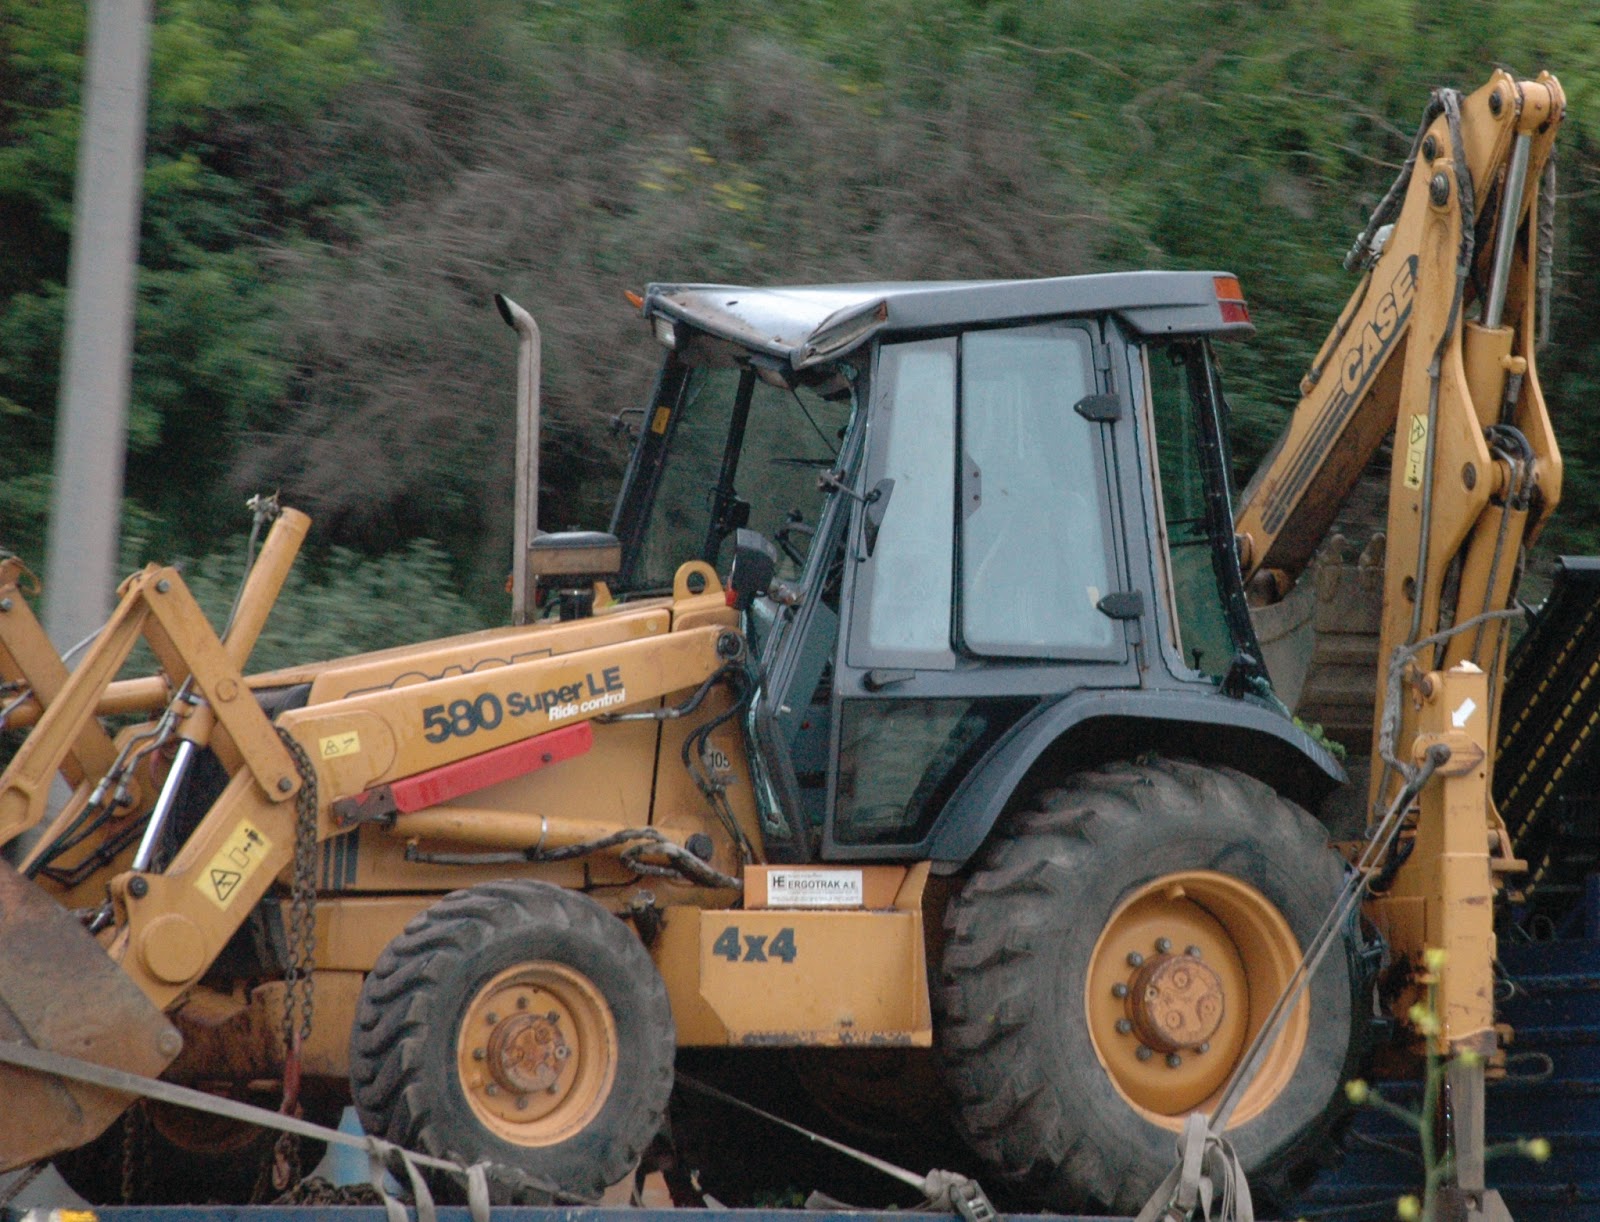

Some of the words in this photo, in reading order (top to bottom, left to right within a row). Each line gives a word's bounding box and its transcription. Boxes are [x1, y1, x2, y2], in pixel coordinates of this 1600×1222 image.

[1341, 255, 1419, 395] CASE
[423, 693, 503, 744] 580
[506, 681, 583, 716] Super
[586, 666, 624, 697] LE
[549, 704, 579, 721] Ride
[580, 688, 626, 712] control
[788, 880, 840, 889] ERGOTRAK
[713, 926, 797, 963] 4x4
